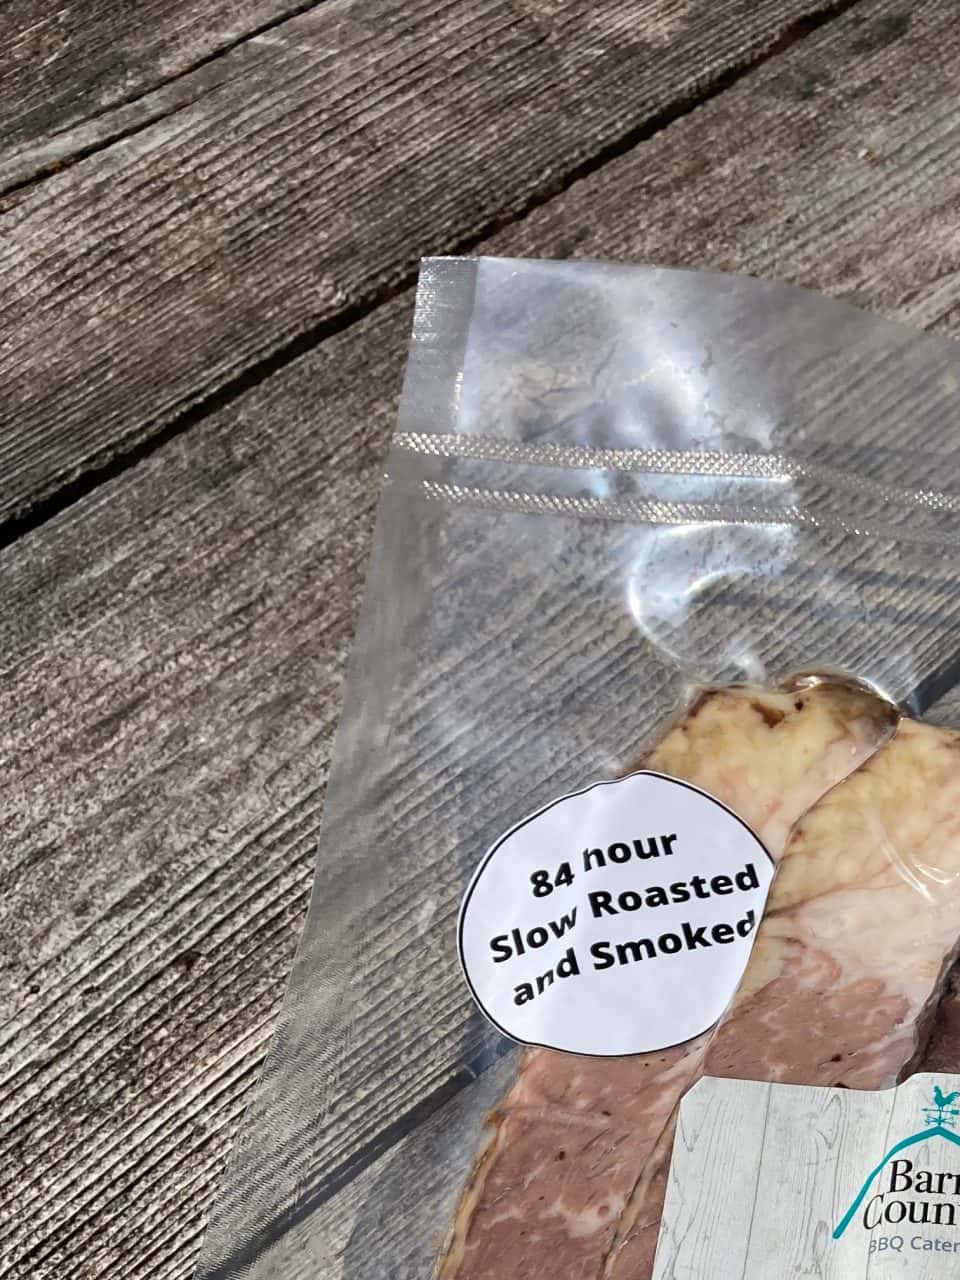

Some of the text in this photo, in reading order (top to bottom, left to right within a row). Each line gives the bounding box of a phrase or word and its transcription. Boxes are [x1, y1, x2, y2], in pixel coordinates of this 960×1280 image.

[529, 833, 678, 898] 84 hour
[489, 864, 760, 963] Slow Roasted
[513, 910, 755, 1006] and Smoked
[869, 1235, 904, 1254] BBQ
